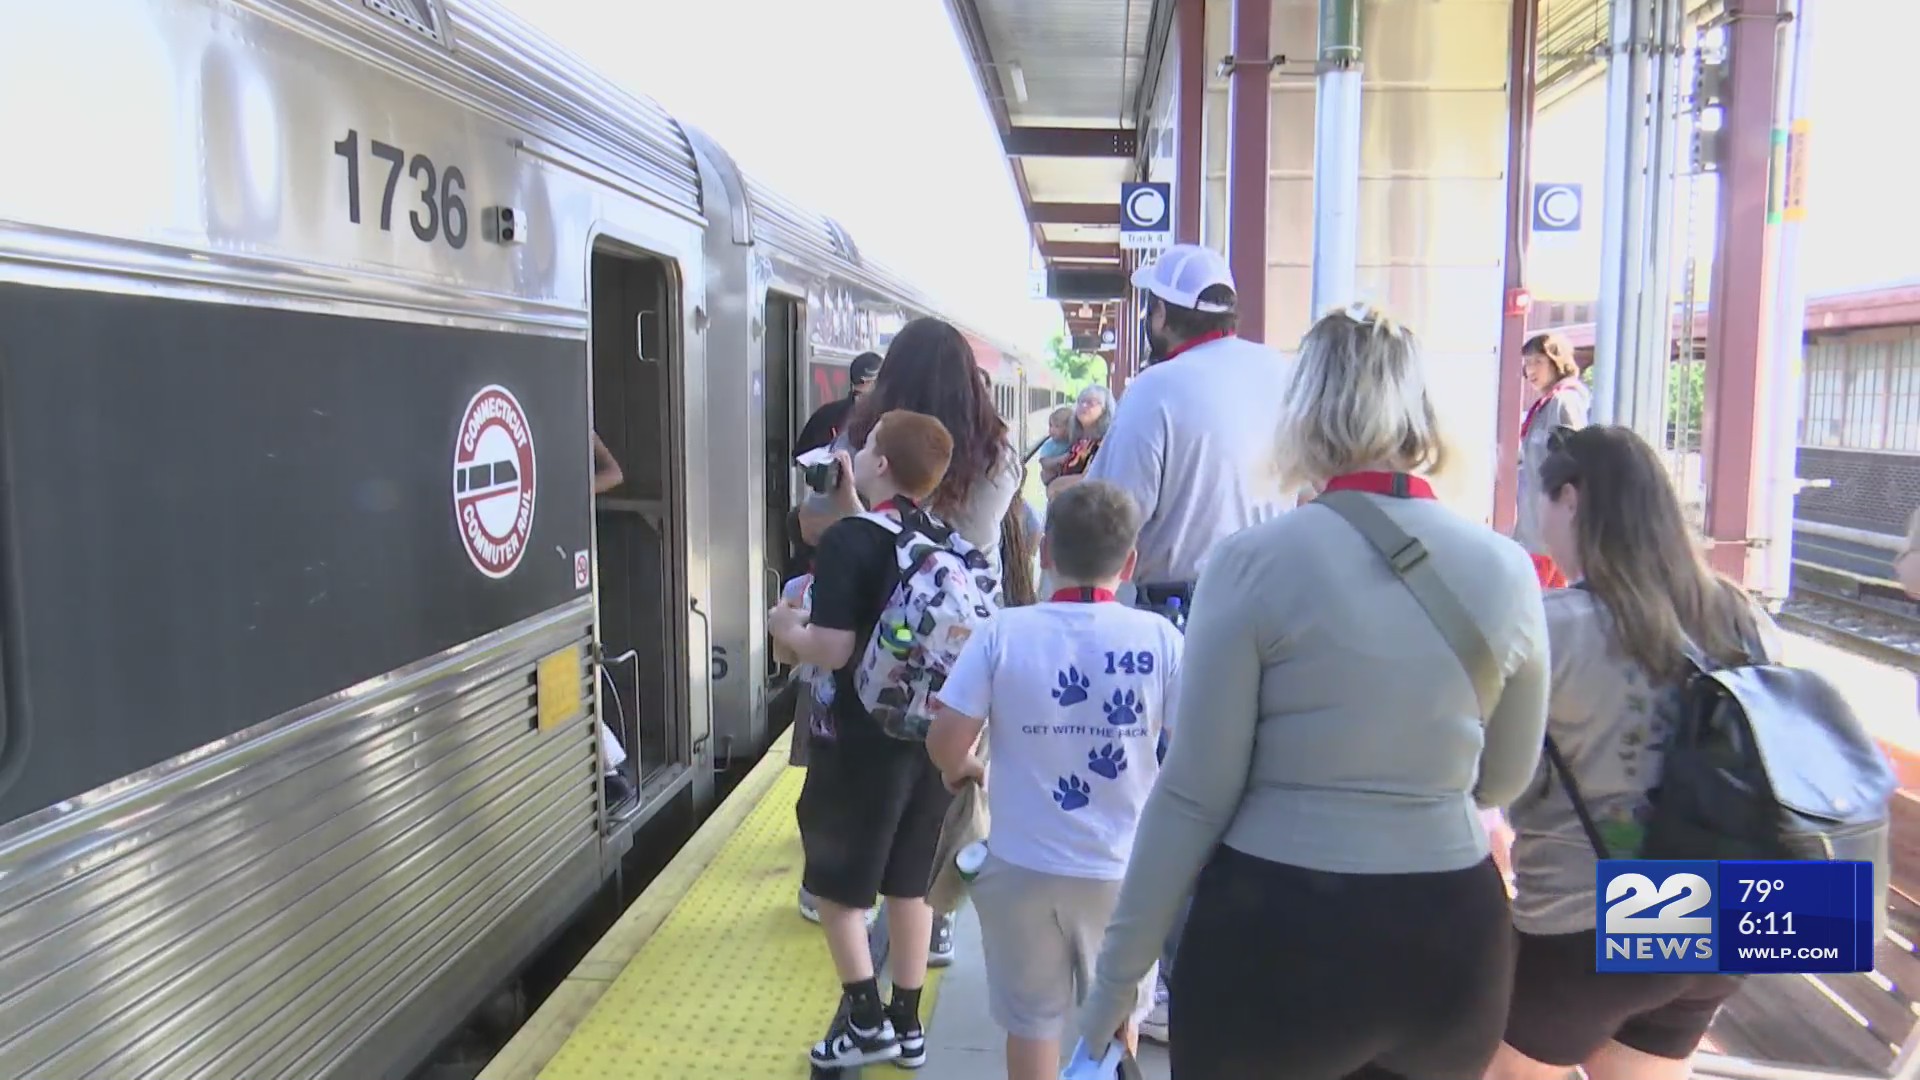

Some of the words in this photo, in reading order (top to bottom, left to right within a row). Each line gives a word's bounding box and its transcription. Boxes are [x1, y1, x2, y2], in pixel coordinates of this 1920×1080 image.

[334, 128, 468, 250] 1736
[1130, 191, 1155, 223] C
[1543, 190, 1568, 223] C
[1128, 234, 1153, 243] Track
[463, 397, 528, 453] CONNECTICUT
[463, 503, 520, 565] COMMUTER
[516, 489, 532, 538] RAIL
[1104, 650, 1154, 675] 149
[1022, 725, 1048, 736] GET
[1053, 725, 1086, 735] WITH
[1090, 726, 1115, 738] THE
